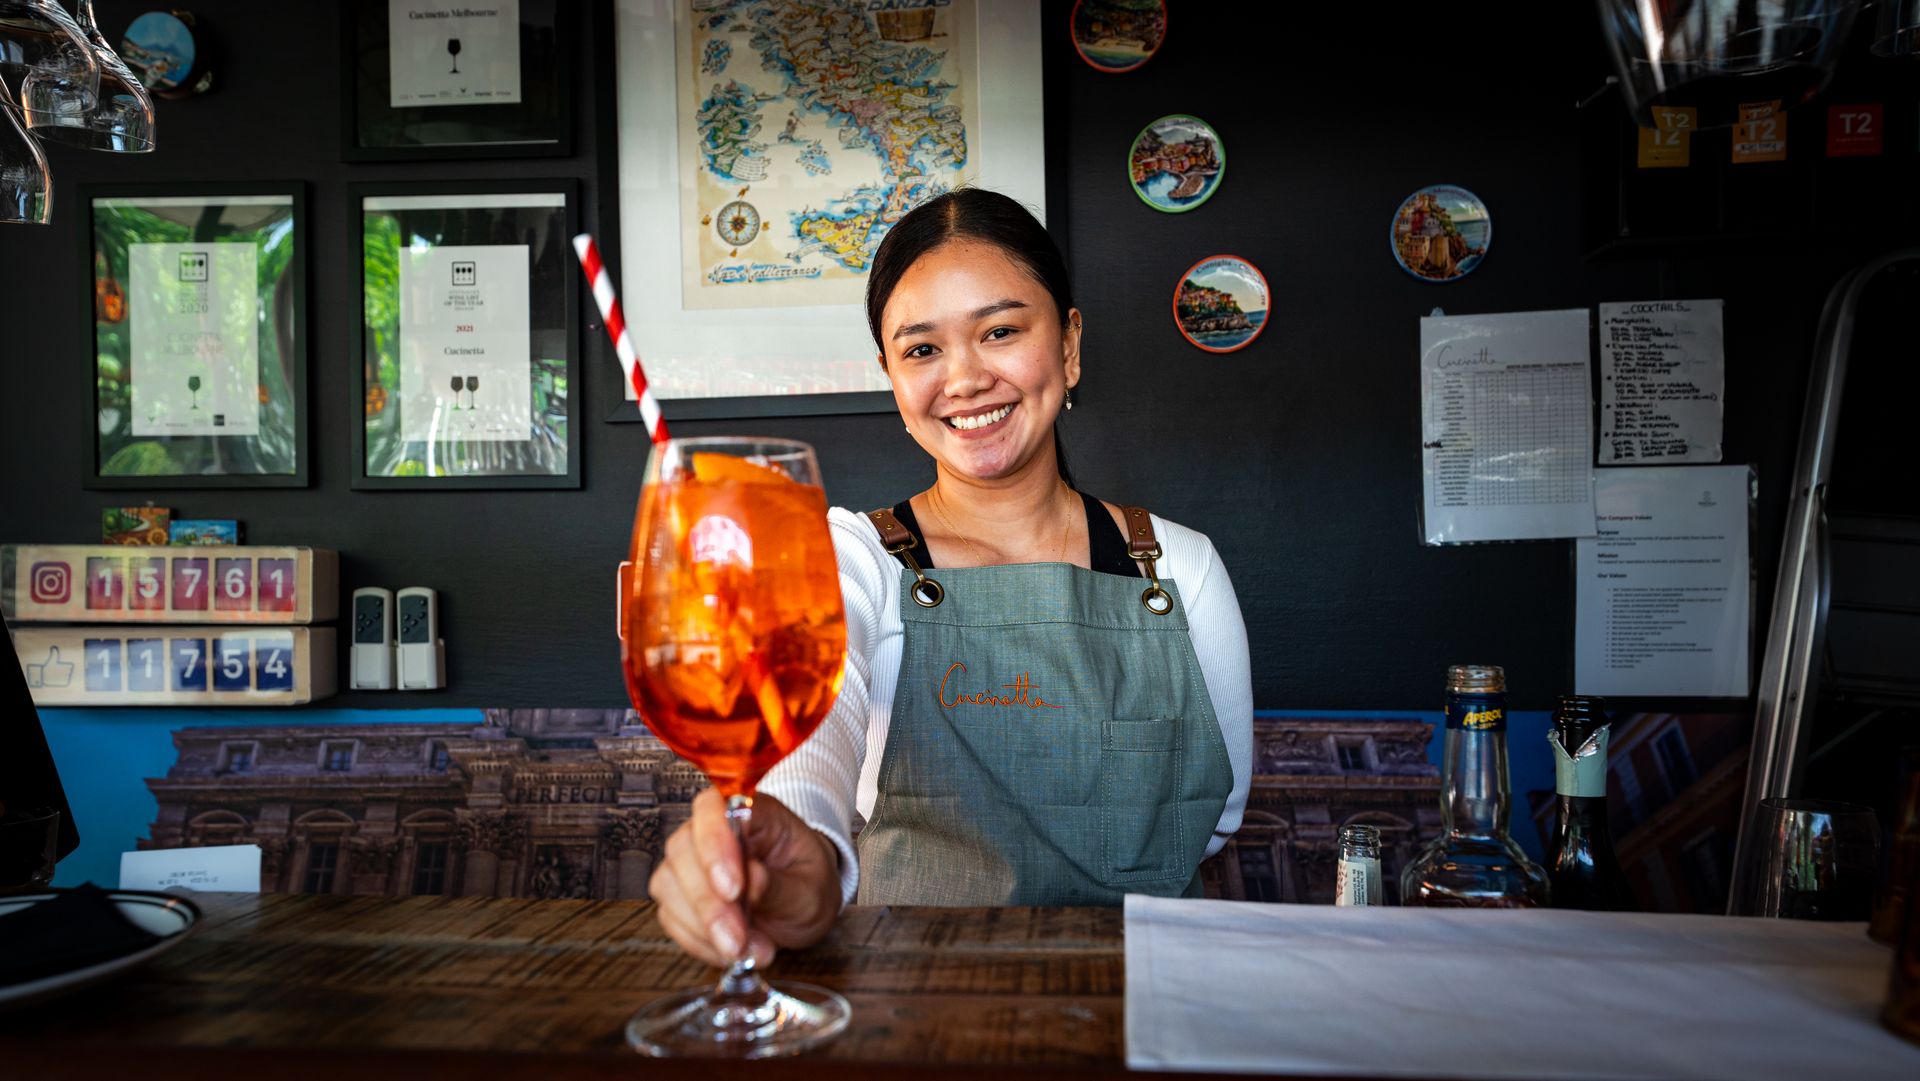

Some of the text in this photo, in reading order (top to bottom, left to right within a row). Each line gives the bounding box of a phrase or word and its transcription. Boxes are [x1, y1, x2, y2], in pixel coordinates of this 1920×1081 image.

[409, 8, 498, 20] Cucinetta Melbourne
[1662, 113, 1689, 128] T2
[1840, 113, 1872, 134] T2
[1747, 119, 1776, 140] T2
[181, 303, 209, 314] 2020
[456, 325, 474, 333] 2021
[444, 346, 485, 356] Cucinetta
[939, 661, 1065, 709] Cucinetta
[1463, 709, 1502, 726] APEROL
